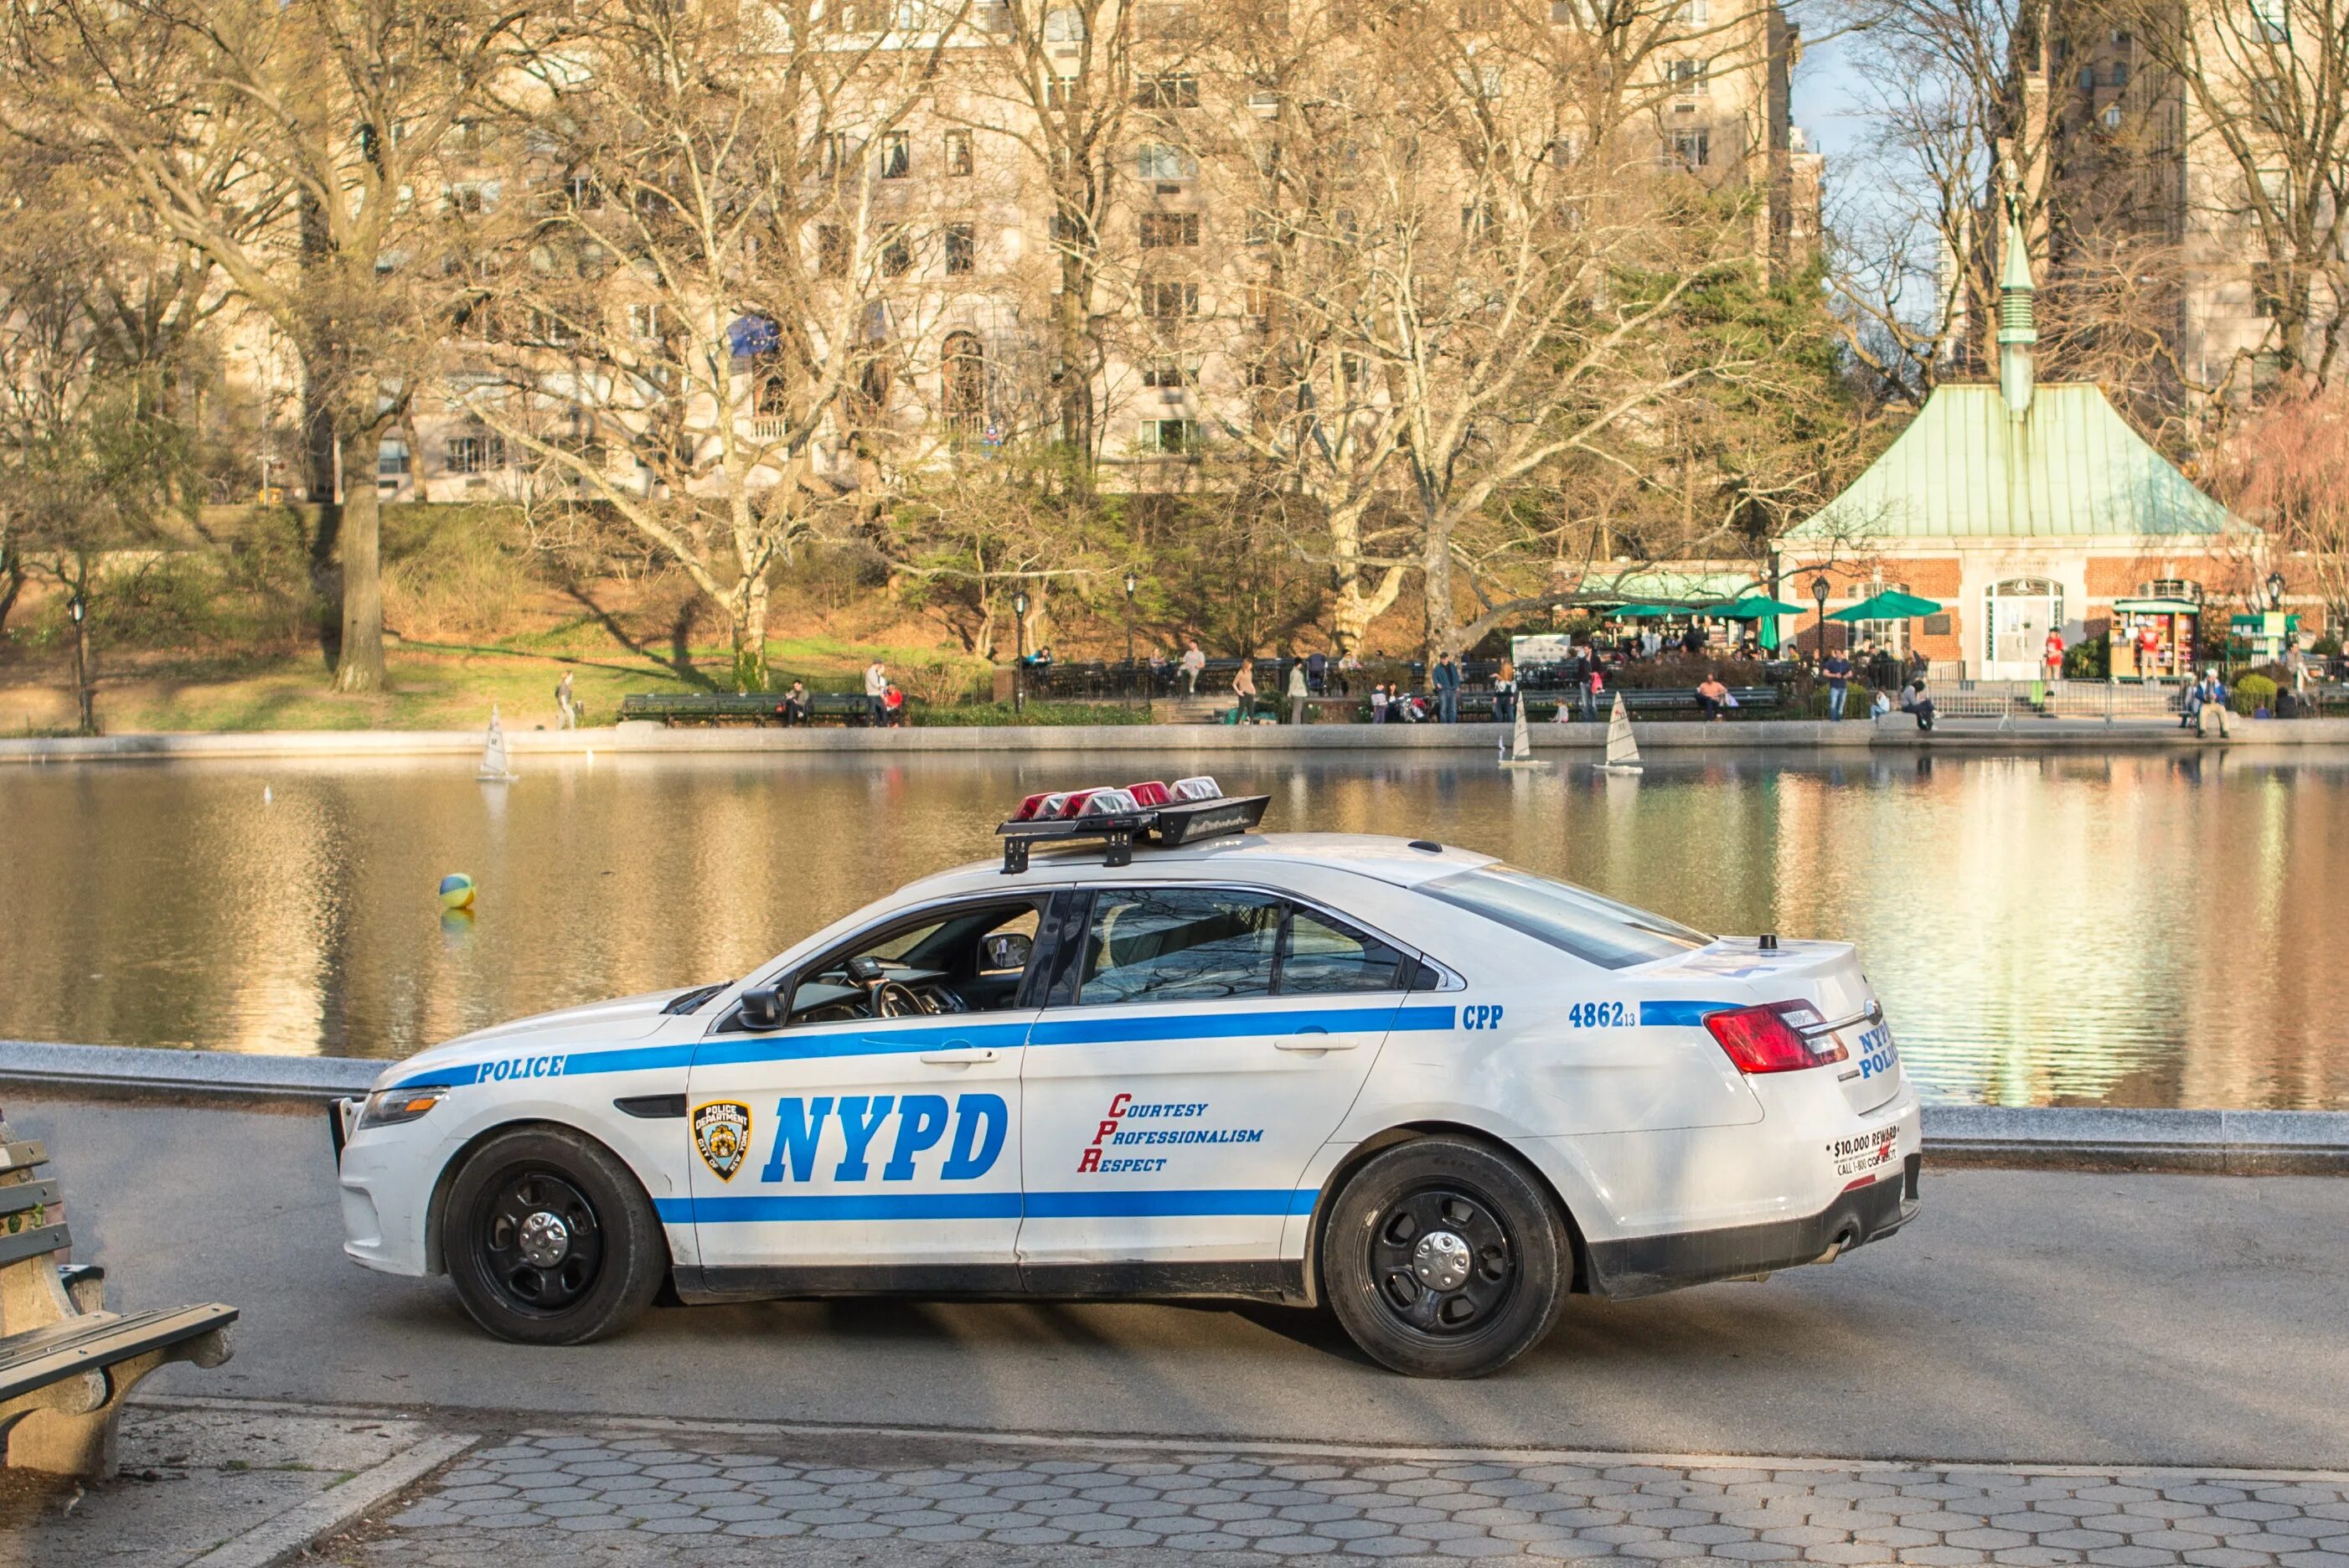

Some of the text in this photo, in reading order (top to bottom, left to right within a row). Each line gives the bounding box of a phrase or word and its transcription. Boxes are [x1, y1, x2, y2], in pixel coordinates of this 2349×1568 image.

[1463, 1005, 1504, 1029] CPP
[1568, 1002, 1635, 1028] 4862 13
[478, 1055, 565, 1083] POLICE
[705, 1104, 737, 1116] POLICE
[1107, 1093, 1209, 1118] COURTESY
[695, 1112, 748, 1130] DEPARTMENT
[1092, 1120, 1264, 1145] PROFESSIONALISM
[729, 1129, 748, 1171] NEW YORK
[761, 1093, 1009, 1183] NYPD
[1834, 1135, 1870, 1158] $10,000
[1871, 1125, 1897, 1147] REWARD
[698, 1138, 719, 1168] CITY OF
[1076, 1148, 1167, 1173] RESPECT
[1837, 1161, 1852, 1175] CALL
